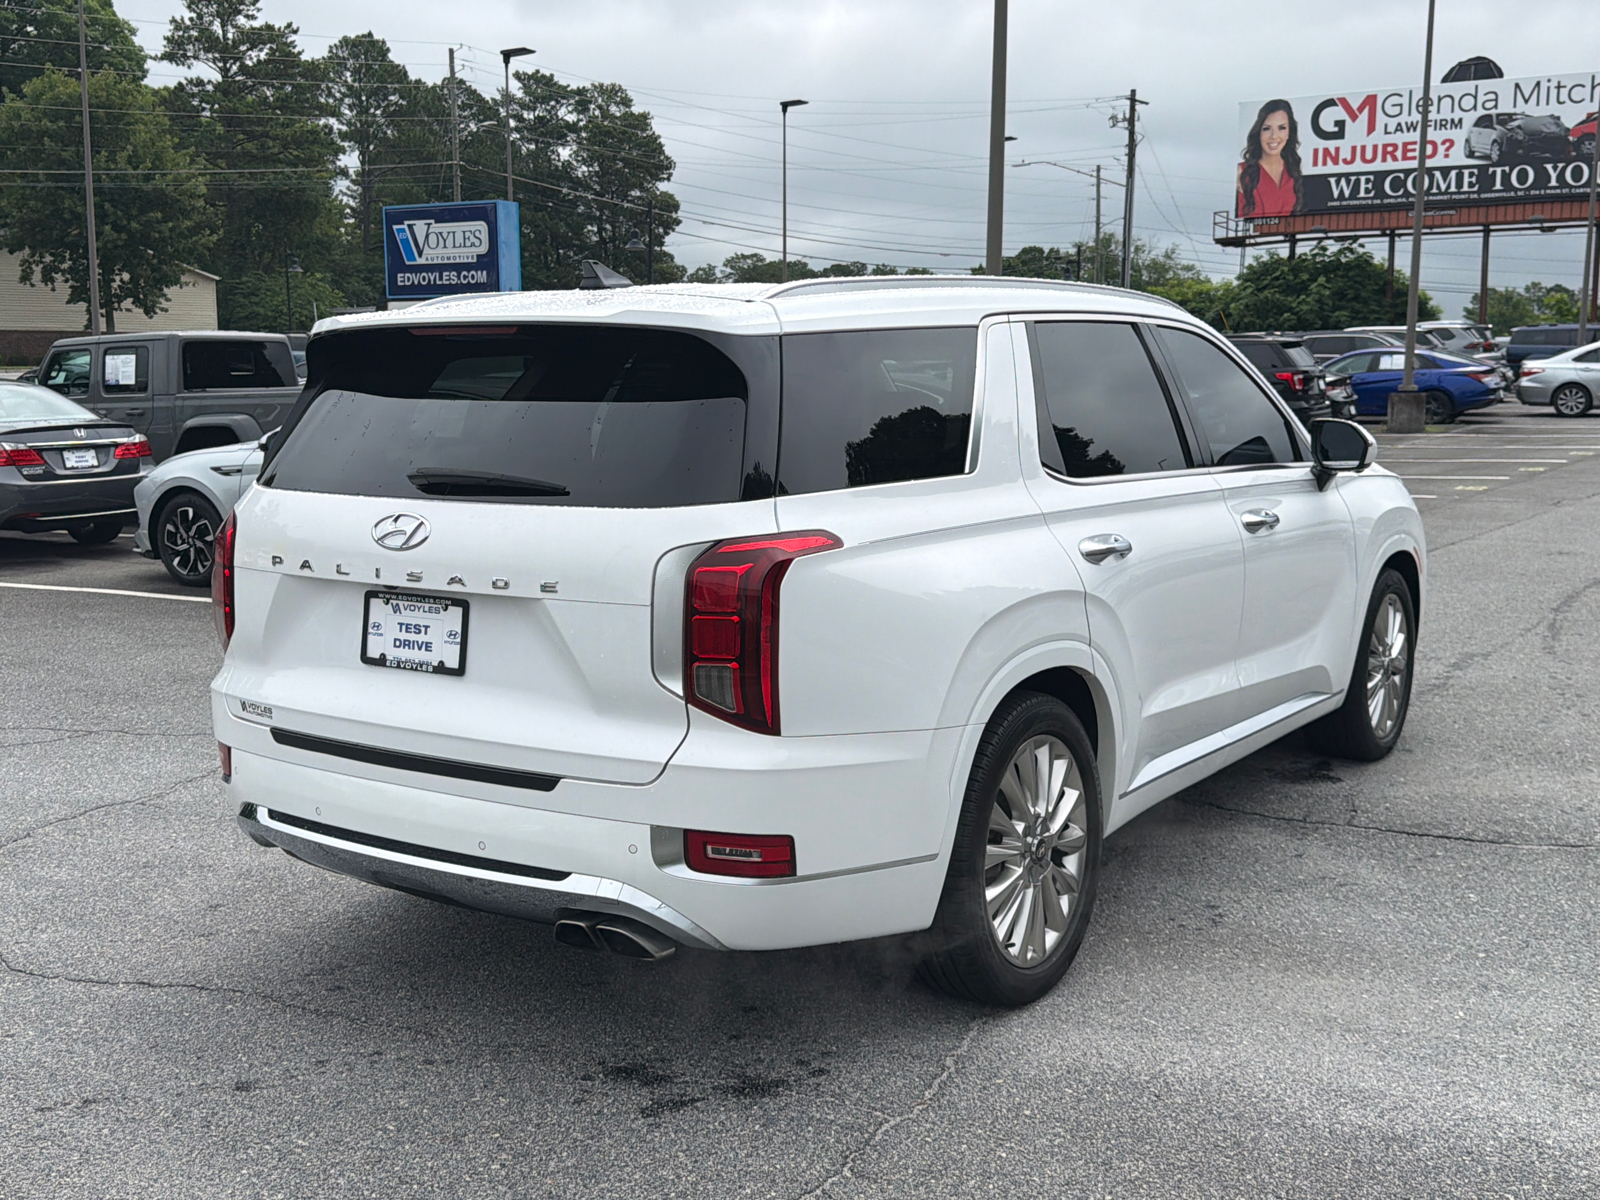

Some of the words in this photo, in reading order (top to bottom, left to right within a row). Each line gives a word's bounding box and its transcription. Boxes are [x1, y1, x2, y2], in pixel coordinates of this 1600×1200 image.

[1381, 84, 1498, 118] Glenda
[1310, 94, 1377, 141] GM
[1384, 119, 1419, 135] LAW
[1312, 138, 1455, 167] INJURED?
[1328, 175, 1375, 200] WE
[1384, 168, 1479, 196] COME
[1489, 164, 1535, 190] TO
[1543, 161, 1600, 187] YO
[406, 222, 483, 259] VOYLES
[425, 254, 475, 262] AUTOMOTIVE
[397, 270, 487, 286] EDVOYLES.COM
[271, 555, 559, 593] PALISADE
[377, 592, 452, 605] WWW.EDVOYLES.COM
[402, 603, 441, 614] VOYLES
[397, 622, 431, 635] TEST
[393, 638, 433, 652] DRIVE
[386, 659, 398, 667] ED
[400, 660, 434, 672] VOYLES
[247, 701, 273, 714] VOYLES
